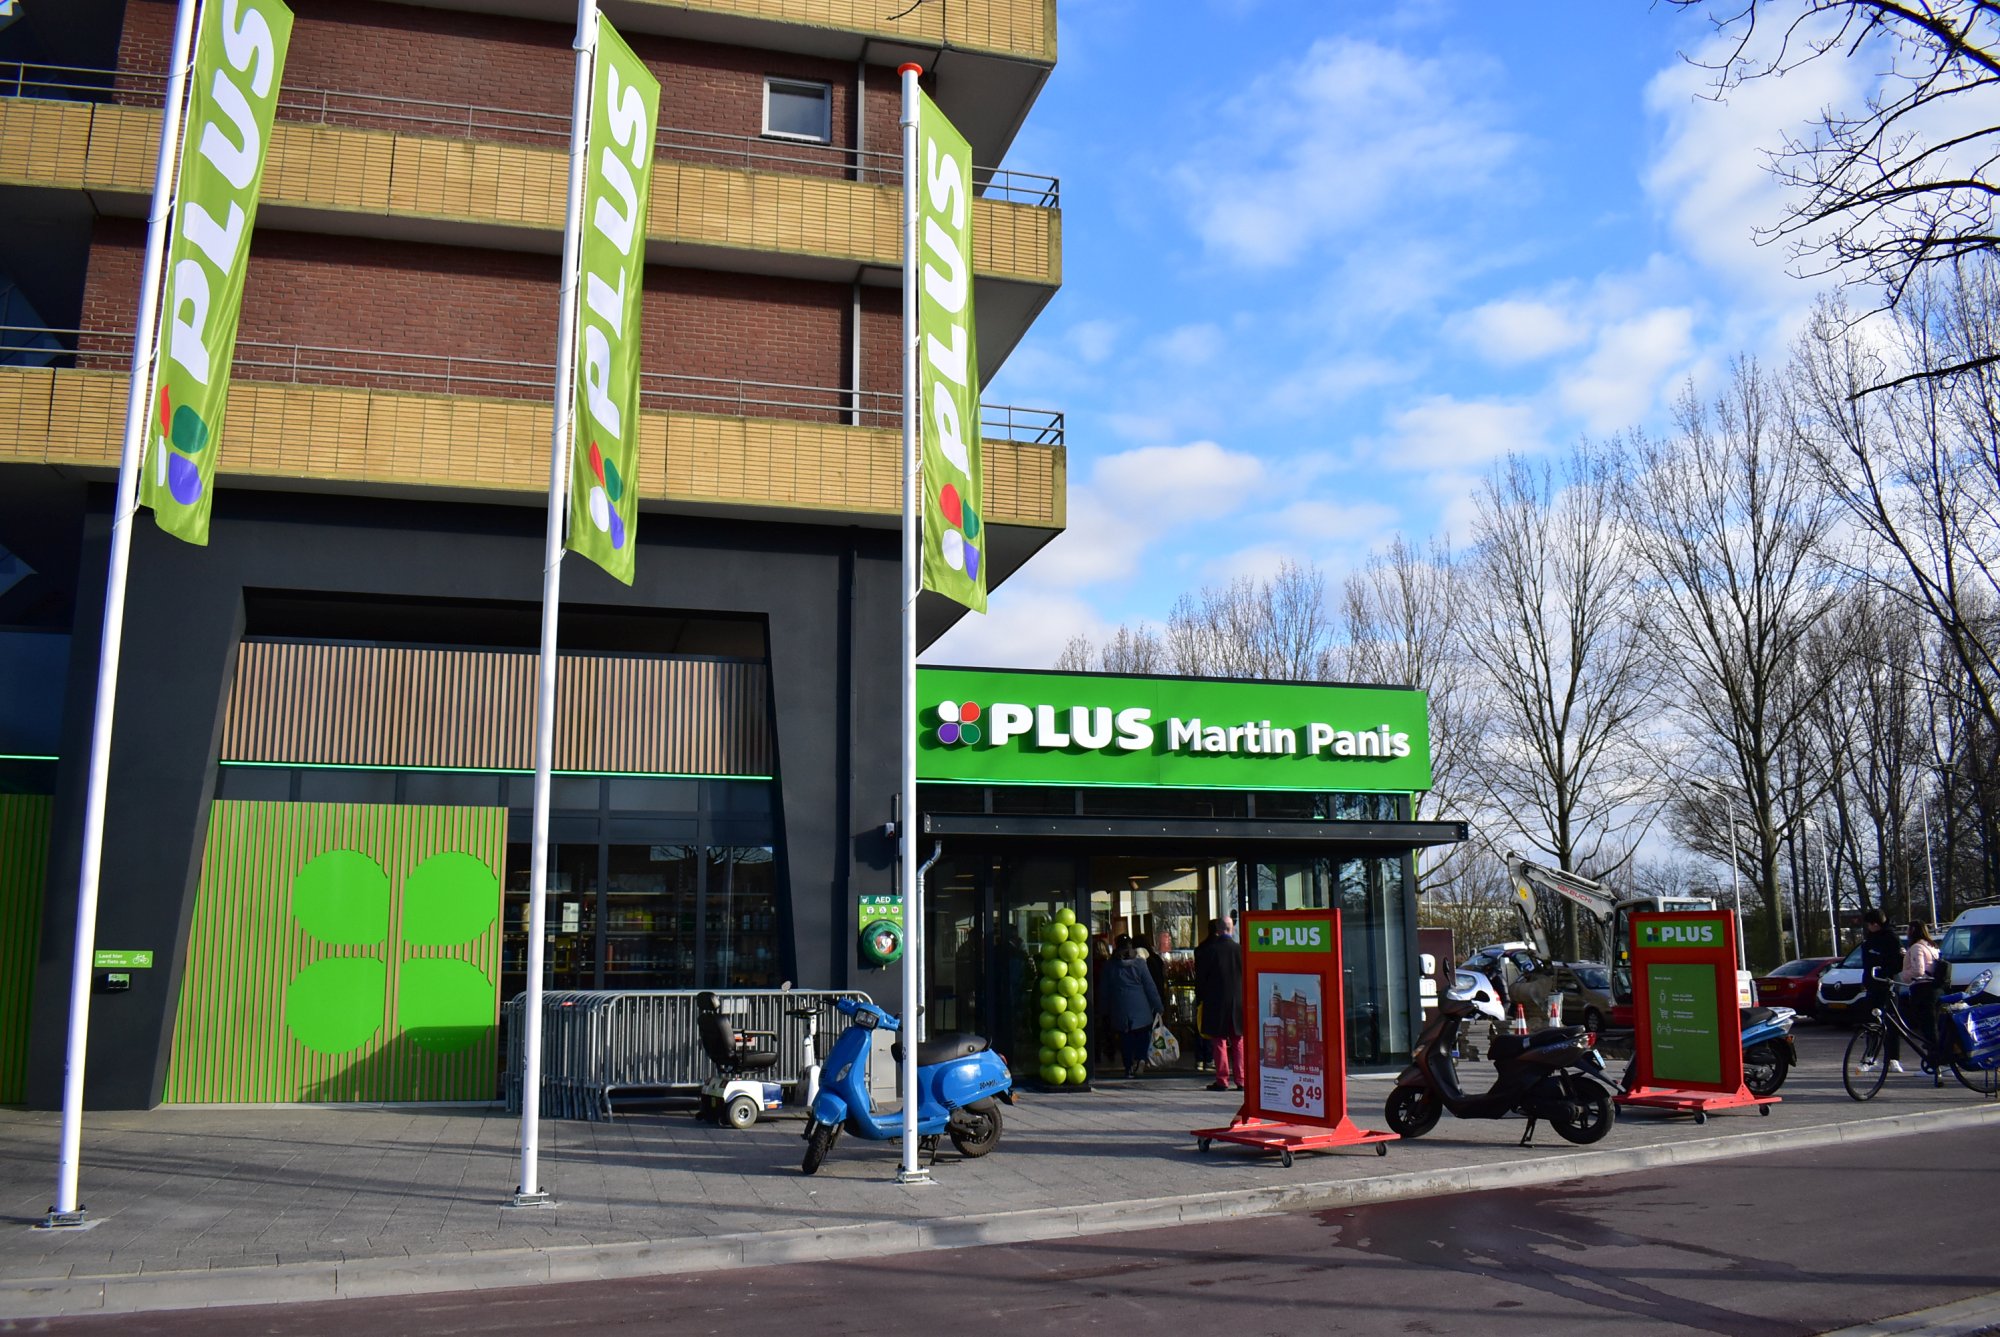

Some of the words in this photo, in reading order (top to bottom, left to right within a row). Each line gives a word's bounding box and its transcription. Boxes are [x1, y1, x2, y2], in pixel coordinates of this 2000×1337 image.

[169, 0, 275, 386] PLUS
[585, 63, 648, 440] PLUS
[923, 136, 971, 481] PLUS
[989, 702, 1155, 750] PLUS
[1167, 716, 1296, 755] Martin
[1306, 721, 1411, 759] Panis
[875, 896, 891, 904] AED
[1557, 883, 1593, 904] TAKEUCHI
[1272, 927, 1321, 946] PLUS
[1661, 926, 1713, 942] PLUS
